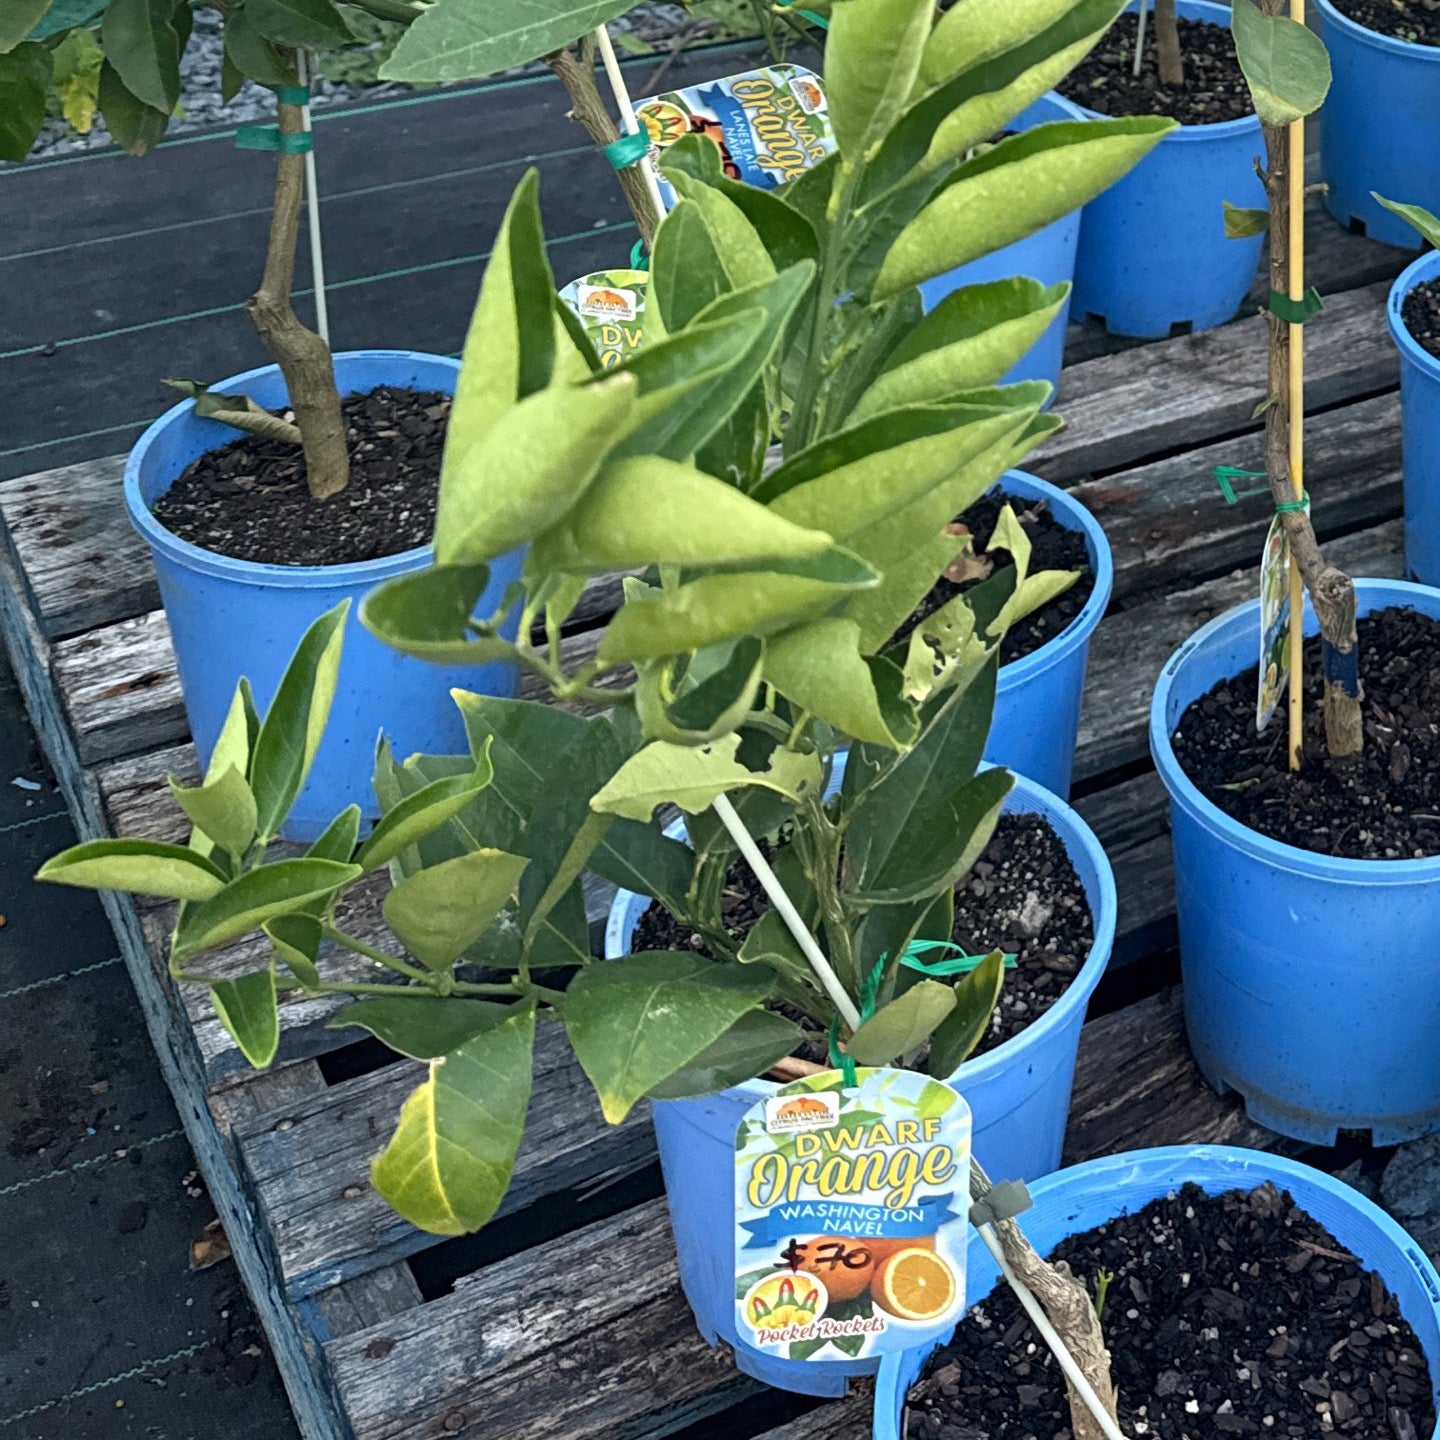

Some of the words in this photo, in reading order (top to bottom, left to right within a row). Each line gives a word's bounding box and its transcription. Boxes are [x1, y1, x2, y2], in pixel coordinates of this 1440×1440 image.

[726, 127, 740, 160] NAVEL
[730, 110, 751, 145] LANES
[731, 79, 808, 182] Orange
[777, 95, 826, 160] DWAR
[796, 1118, 942, 1157] DWARF
[748, 1145, 956, 1208] Orange
[779, 1202, 924, 1222] WASHINGTON
[823, 1219, 883, 1236] NAVEL
[758, 1323, 820, 1345] Pocket
[821, 1316, 885, 1337] Rockets
